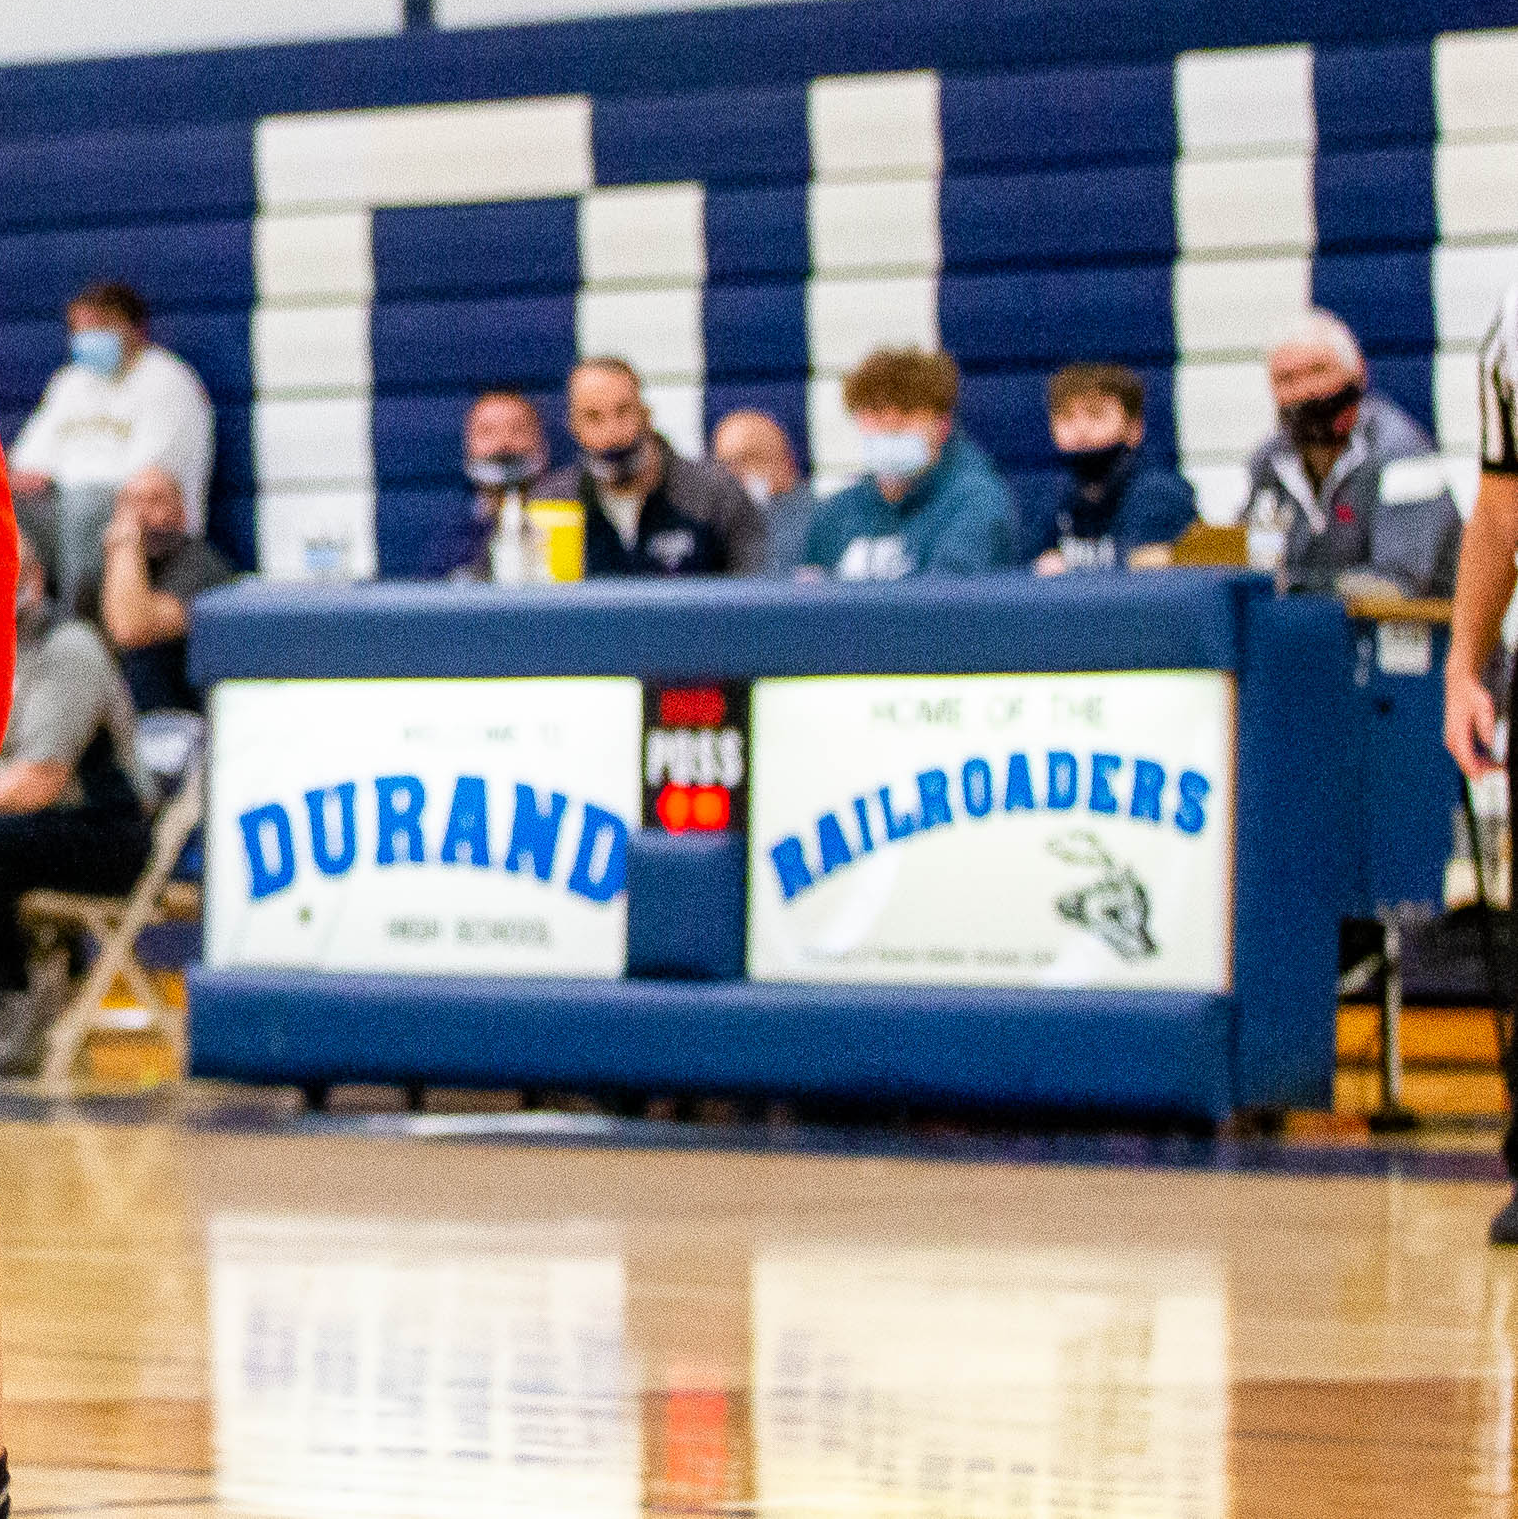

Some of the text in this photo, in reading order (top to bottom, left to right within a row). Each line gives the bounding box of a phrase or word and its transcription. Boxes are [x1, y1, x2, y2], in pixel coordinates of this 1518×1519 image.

[645, 727, 744, 787] POSS
[238, 773, 630, 904] DURAND
[769, 749, 1212, 902] RAILROADERS
